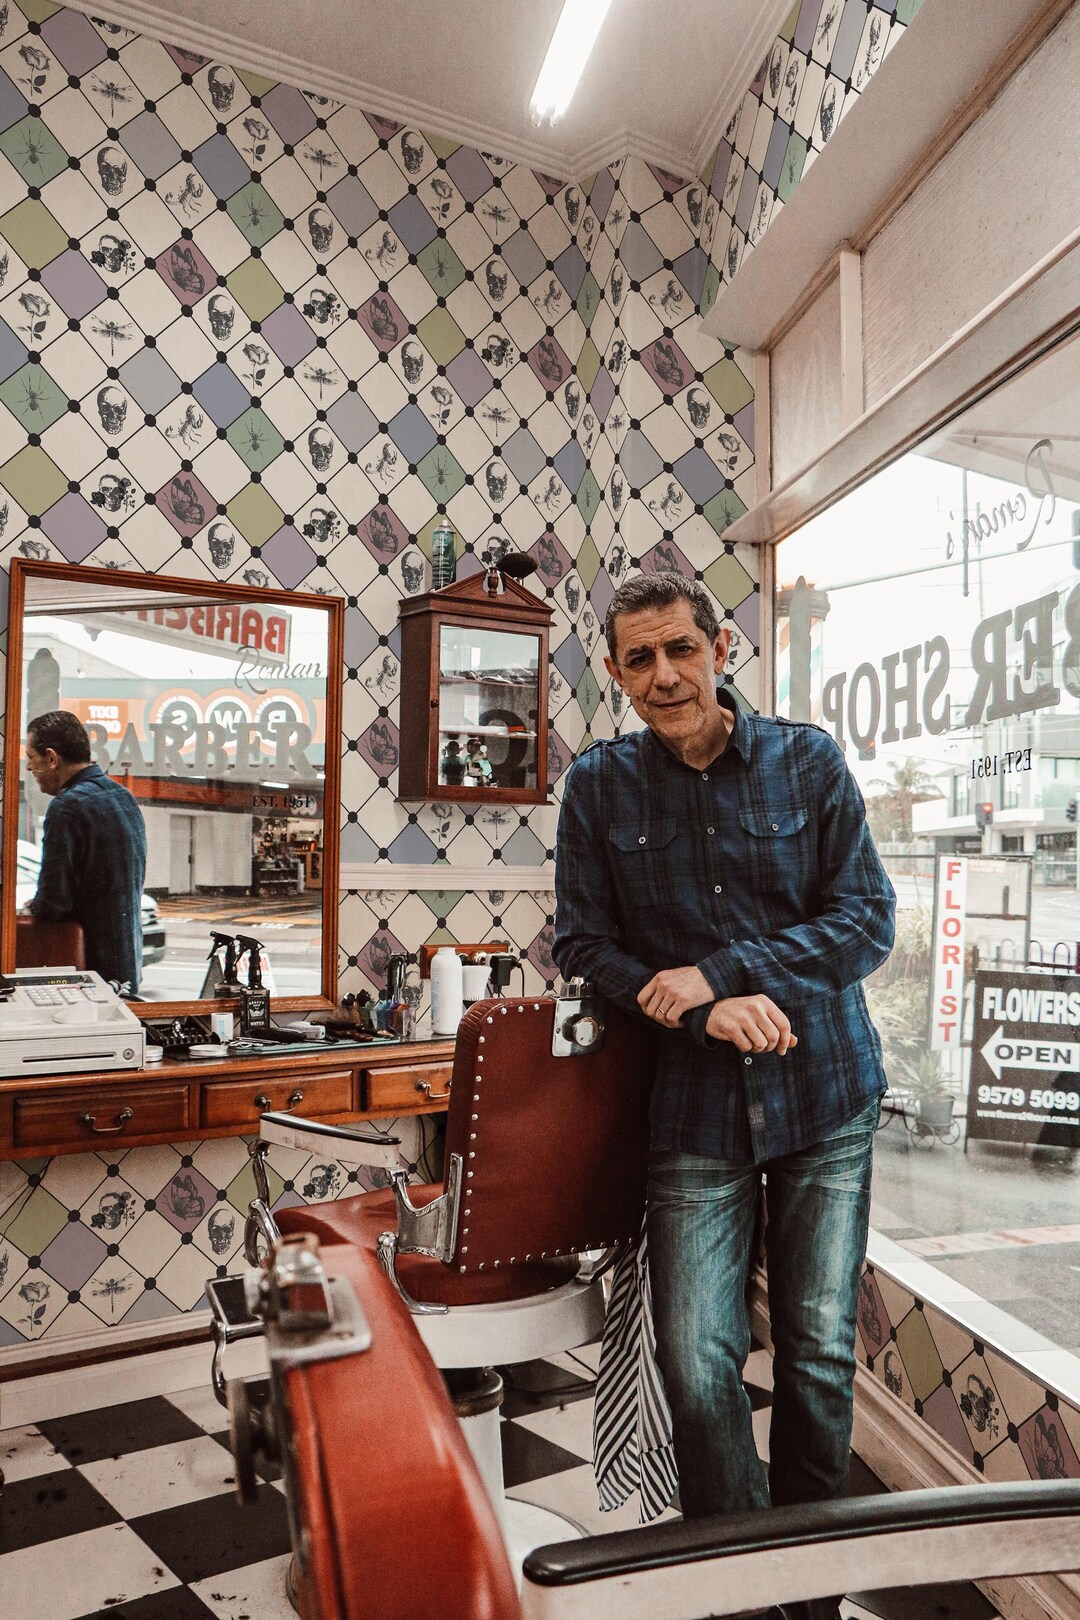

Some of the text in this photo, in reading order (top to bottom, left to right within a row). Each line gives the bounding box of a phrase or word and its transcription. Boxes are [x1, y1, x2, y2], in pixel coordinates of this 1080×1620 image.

[234, 645, 321, 694] Roman
[81, 722, 319, 779] BARBER
[252, 796, 310, 808] EST. 1951
[938, 861, 962, 1042] FLORIST
[982, 986, 1080, 1026] FLOWERS
[994, 1043, 1072, 1065] OPEN
[977, 1084, 1080, 1111] 9579 5099
